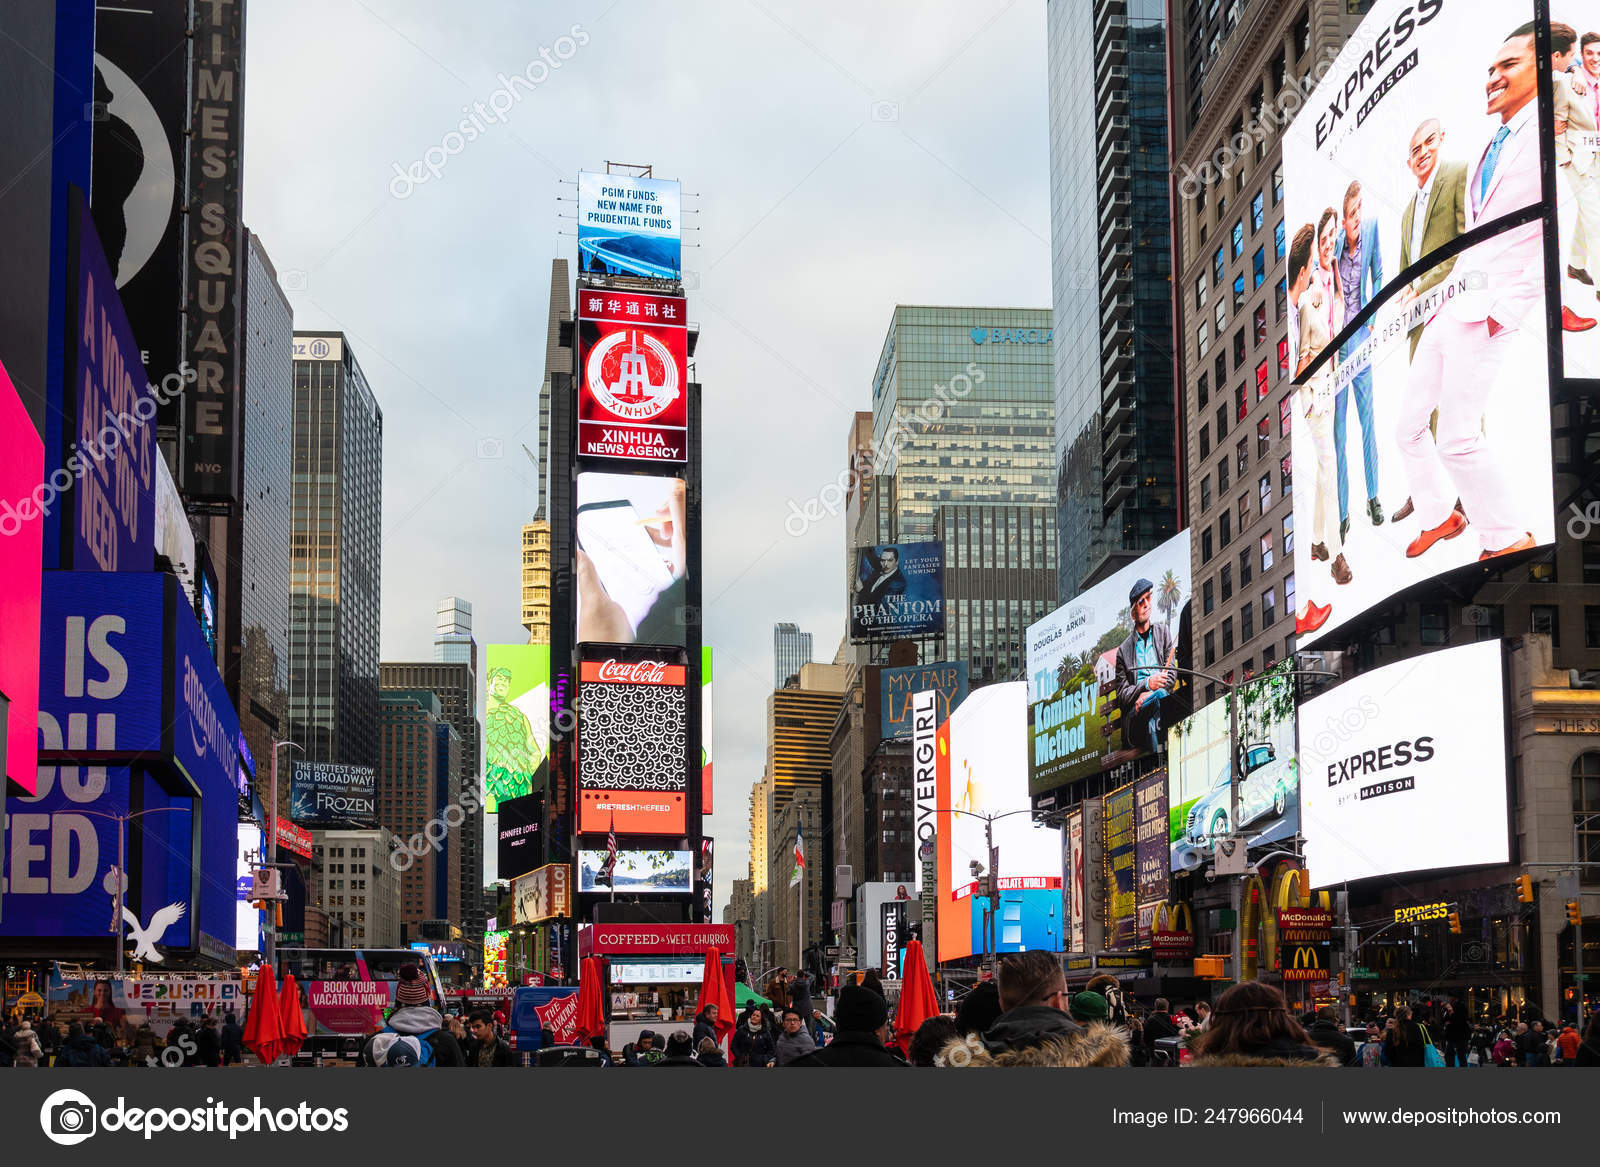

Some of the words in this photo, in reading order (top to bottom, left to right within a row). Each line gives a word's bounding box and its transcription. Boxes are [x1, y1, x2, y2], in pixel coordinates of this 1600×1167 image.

[1316, 0, 1443, 151] EXPRESS
[199, 0, 234, 179] TIMES
[1357, 55, 1415, 120] MADISON
[601, 187, 625, 198] PGIM
[627, 190, 658, 201] FUNDS:
[597, 200, 616, 210] NEW
[619, 203, 643, 213] NAME
[645, 205, 663, 215] FOR
[588, 212, 640, 226] PRUDENTIAL
[643, 217, 672, 229] FUNDS
[194, 202, 233, 434] SQUARE
[589, 298, 676, 318] 新华通讯社
[1334, 338, 1378, 388] WORKWEAR
[1382, 278, 1467, 343] DESTINATION
[609, 399, 662, 416] XINHUA
[602, 429, 665, 446] XINHUA
[587, 442, 624, 454] NEWS
[626, 446, 679, 458] AGENCY
[195, 463, 222, 473] NYC
[853, 600, 941, 618] PHANTOM
[885, 595, 907, 603] THE
[860, 617, 874, 626] OF
[876, 615, 897, 625] THE
[899, 613, 933, 623] OPERA
[1033, 629, 1063, 652] DOUGLAS
[1066, 614, 1087, 634] ARKIN
[64, 614, 128, 700] IS
[599, 659, 668, 683] Coca-Cola
[889, 673, 916, 692] MY
[922, 669, 958, 689] FAIR
[1034, 667, 1059, 701] The
[184, 655, 216, 753] amazon
[888, 687, 958, 723] LAY
[1034, 681, 1098, 735] Kominsky
[1035, 716, 1086, 767] Method
[296, 762, 311, 770] THE
[314, 764, 348, 773] HOTTEST
[1039, 765, 1058, 778] NETFLIX
[1059, 757, 1081, 773] ORIGINAL
[1082, 750, 1099, 763] SERIES
[1328, 736, 1434, 787] EXPRESS
[295, 770, 310, 780] ON
[315, 772, 374, 785] BROADWAY!
[1361, 780, 1412, 798] MADISON
[317, 793, 374, 813] FROZEN
[596, 803, 670, 812] #REFRESHTHEFEED
[500, 827, 521, 840] JENNIFER
[523, 823, 538, 833] LOPEZ
[0, 813, 128, 895] ED.
[922, 861, 934, 923] EXPERIENCE
[997, 878, 1022, 889] COLATE
[1023, 878, 1046, 888] WORLD
[1281, 913, 1332, 921] McDonald's
[1394, 902, 1448, 923] EXPRESS
[599, 934, 660, 945] COFFEED
[666, 934, 691, 944] SWEET
[694, 933, 730, 944] CHURROS
[886, 907, 897, 980] OVERGIRL
[1153, 934, 1193, 942] McDonald's
[323, 981, 349, 993] BOOK
[351, 981, 376, 993] YOUR
[141, 1002, 178, 1017] TEL
[313, 993, 359, 1005] VACATION
[361, 993, 386, 1006] NOW!
[545, 1001, 561, 1022] THE
[551, 998, 577, 1033] ALVATION
